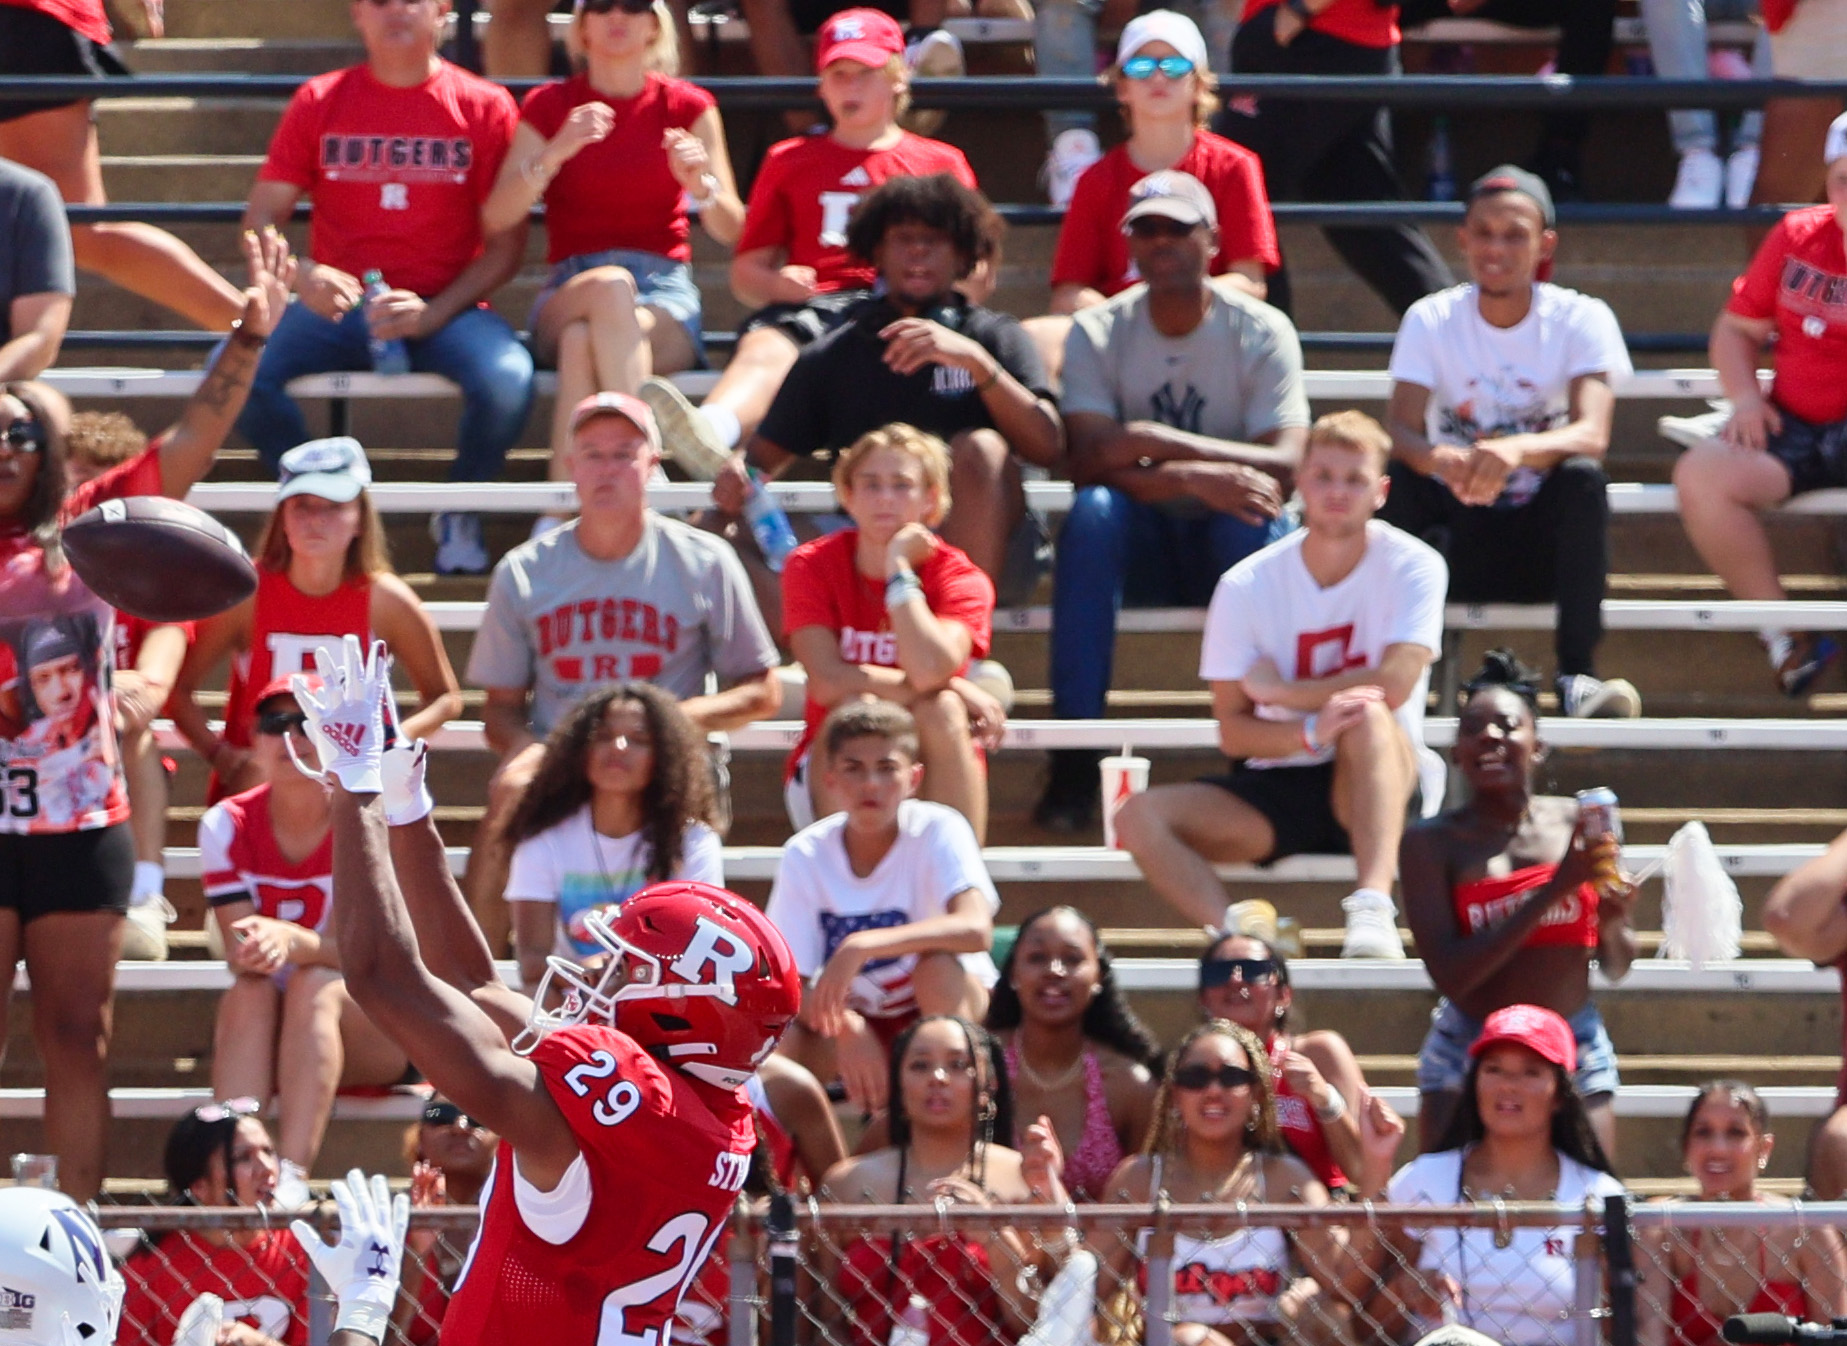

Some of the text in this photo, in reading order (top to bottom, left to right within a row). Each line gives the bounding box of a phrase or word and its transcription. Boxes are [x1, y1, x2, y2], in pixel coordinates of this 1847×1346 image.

[323, 138, 473, 172] RUTGERS
[535, 598, 680, 657] RUTGERS
[594, 658, 623, 683] R
[323, 724, 360, 757] adidas
[687, 915, 765, 1007] R
[563, 1049, 642, 1128] 29
[51, 1208, 108, 1284] N
